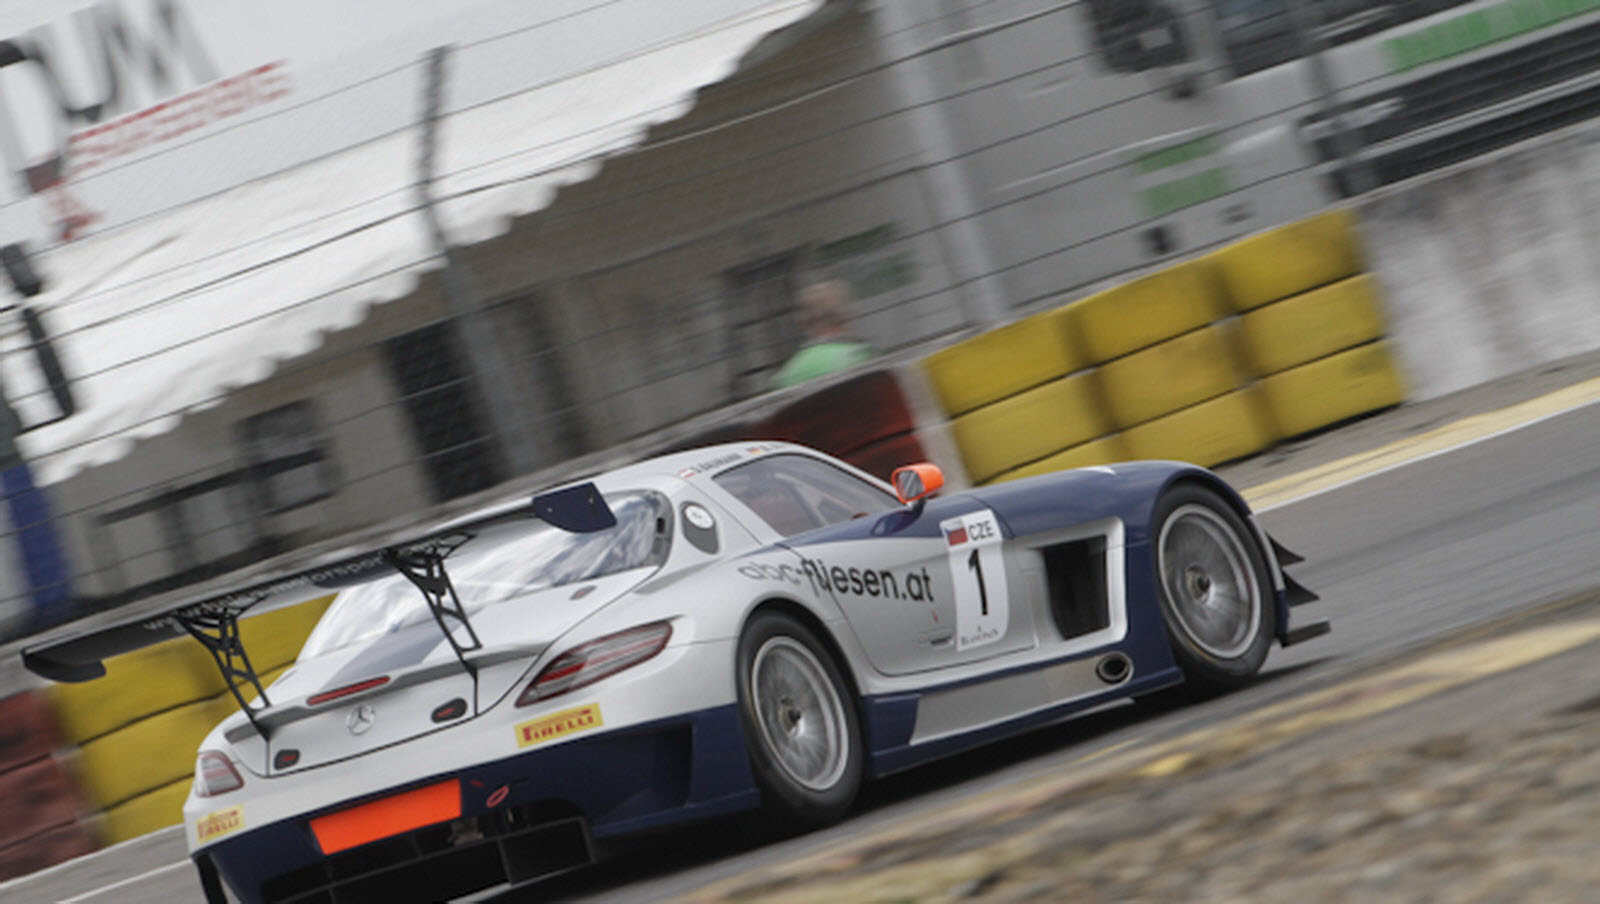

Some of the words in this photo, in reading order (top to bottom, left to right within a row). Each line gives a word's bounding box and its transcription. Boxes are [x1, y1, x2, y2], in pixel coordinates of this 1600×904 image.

[968, 520, 994, 542] CZE
[738, 558, 935, 603] abc-fliesen.at
[967, 548, 989, 617] 1
[522, 707, 594, 742] PIRELLI
